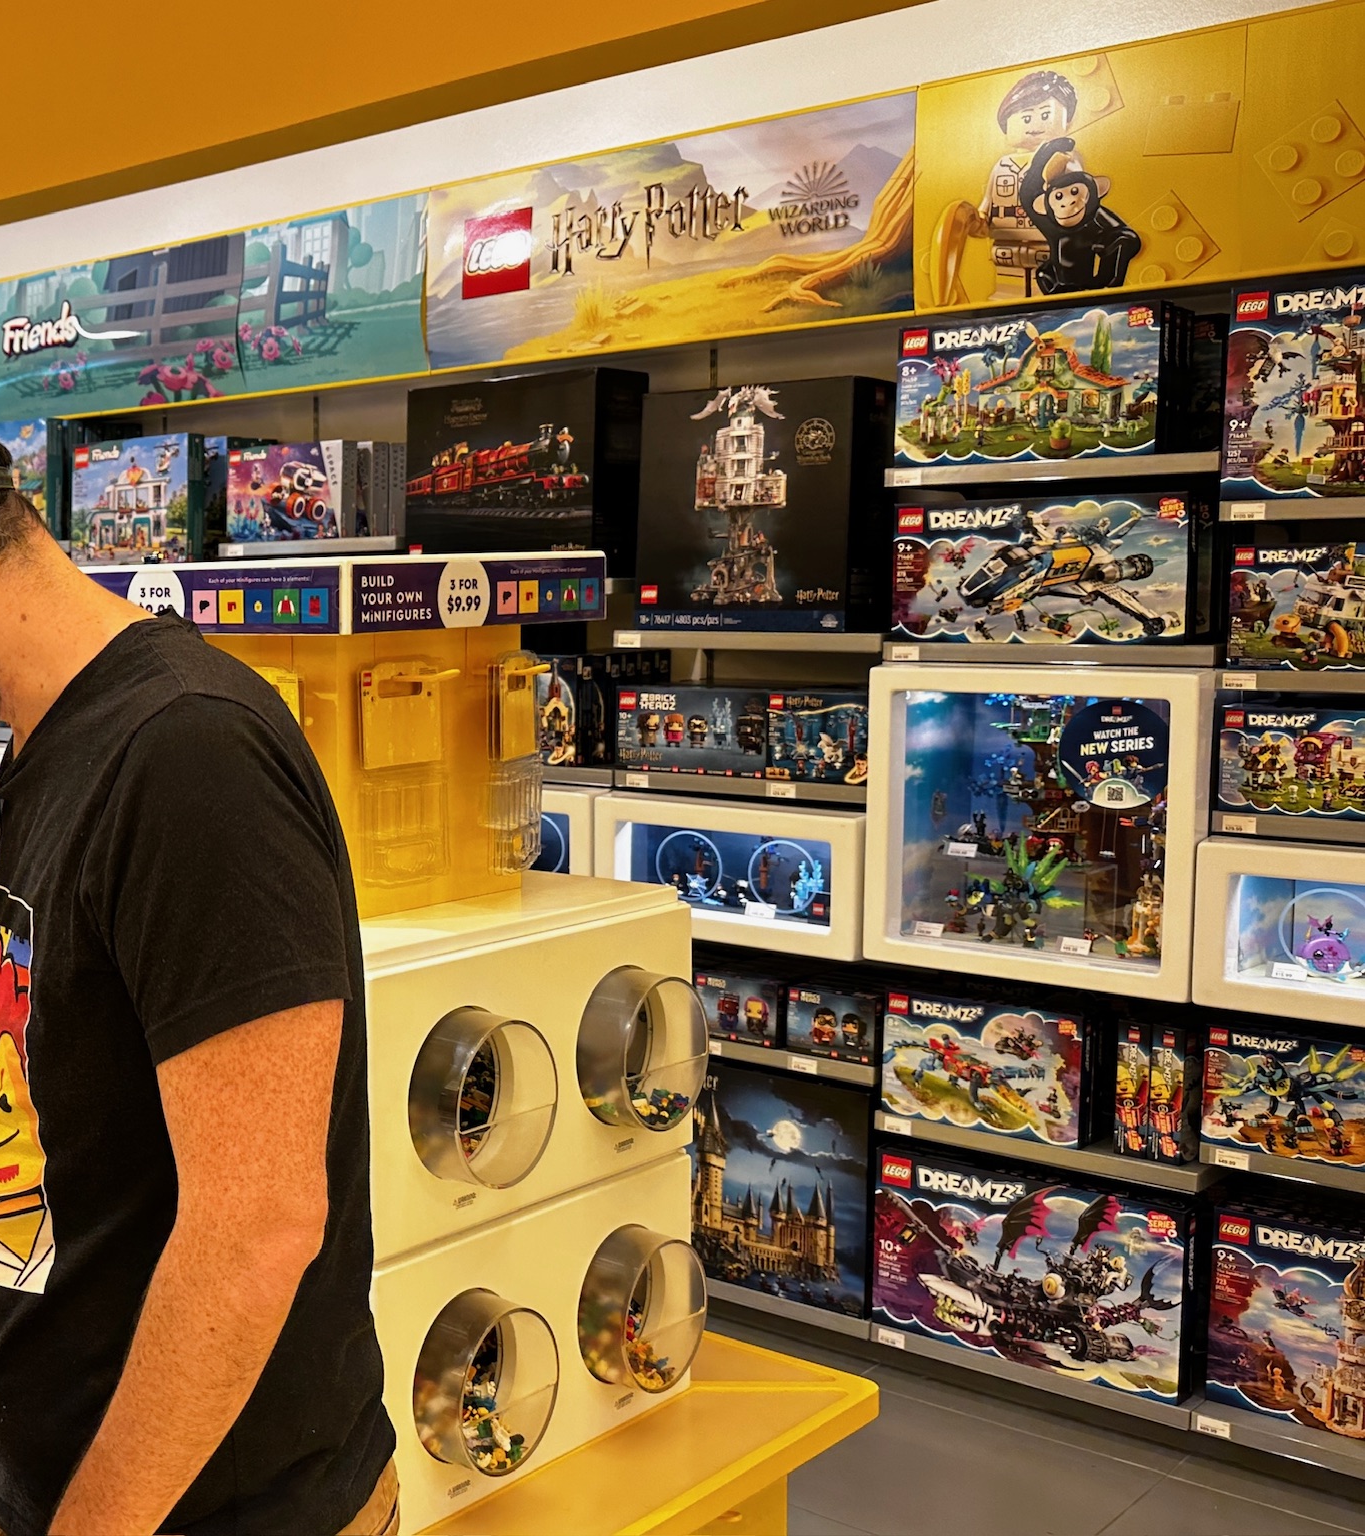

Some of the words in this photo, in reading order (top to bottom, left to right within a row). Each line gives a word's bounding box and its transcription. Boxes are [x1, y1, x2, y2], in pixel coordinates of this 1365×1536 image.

[769, 194, 860, 221] WIZARDING
[544, 199, 640, 277] Harry
[642, 182, 749, 269] Potter
[779, 213, 850, 238] WORLD
[465, 228, 532, 275] LEGO
[1237, 300, 1268, 314] LEGO
[2, 300, 80, 357] Friends
[904, 336, 928, 350] LEGO
[902, 366, 916, 376] 8+
[1229, 420, 1248, 432] 9+
[327, 453, 338, 487] SPACE
[899, 515, 923, 527] LEGO
[897, 543, 912, 553] 9+
[1236, 552, 1254, 560] LEGO
[361, 576, 395, 588] BUILD
[450, 579, 456, 590] 3
[459, 578, 478, 589] FOR
[140, 587, 145, 598] 3
[150, 587, 171, 598] FOR
[361, 593, 394, 606] YOUR
[397, 591, 423, 603] OWN
[795, 589, 817, 604] Harry
[817, 587, 839, 601] Potter
[447, 595, 481, 614] $9.99
[675, 614, 691, 624] 4803
[648, 693, 676, 702] BRICK
[639, 702, 676, 710] HEADZ
[1093, 729, 1122, 740] WATCH
[1122, 726, 1139, 736] THE
[1080, 741, 1109, 756] NEW
[1110, 736, 1154, 753] SERIES
[889, 999, 908, 1008] LEGO
[888, 1018, 899, 1027] 8+
[1210, 1032, 1228, 1041] LEGO
[883, 1163, 911, 1179] LEGO
[1148, 1220, 1176, 1229] SERIES
[1220, 1224, 1248, 1237] LEGO
[878, 1239, 902, 1252] 10+
[1217, 1249, 1235, 1262] 9+
